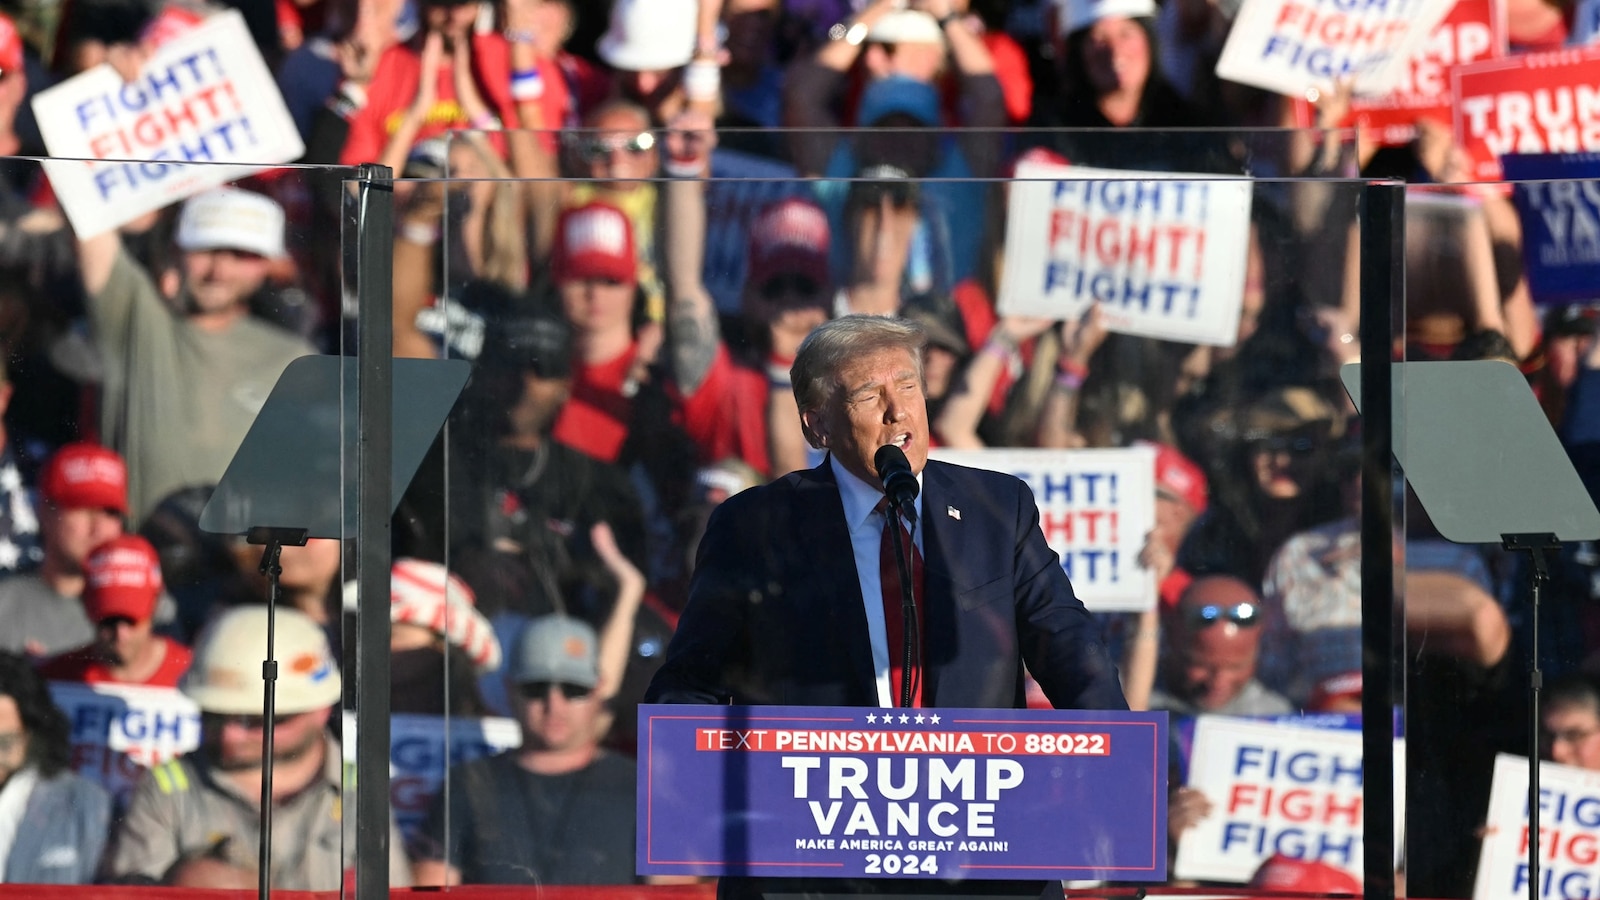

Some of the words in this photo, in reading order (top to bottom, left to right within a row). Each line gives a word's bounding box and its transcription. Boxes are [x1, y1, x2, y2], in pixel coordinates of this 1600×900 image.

[76, 48, 226, 130] FIGHT!
[89, 77, 242, 170] FIGHT!
[94, 116, 258, 200] FIGHT!
[1053, 181, 1208, 220] FIGHT!
[1049, 209, 1206, 280] FIGHT!
[1043, 260, 1200, 318] FIGHT!
[703, 730, 768, 749] TEXT
[776, 731, 975, 752] PENNSYLVANIA
[982, 734, 1017, 753] TO
[1024, 734, 1105, 754] 88022
[782, 756, 1024, 801] TRUMP
[808, 801, 995, 837] VANCE
[796, 839, 835, 850] MAKE
[840, 839, 903, 851] AMERICA
[908, 841, 953, 851] GREAT
[958, 841, 1009, 852] AGAIN!
[865, 854, 938, 875] 2024
[1220, 821, 1363, 865] FIGH
